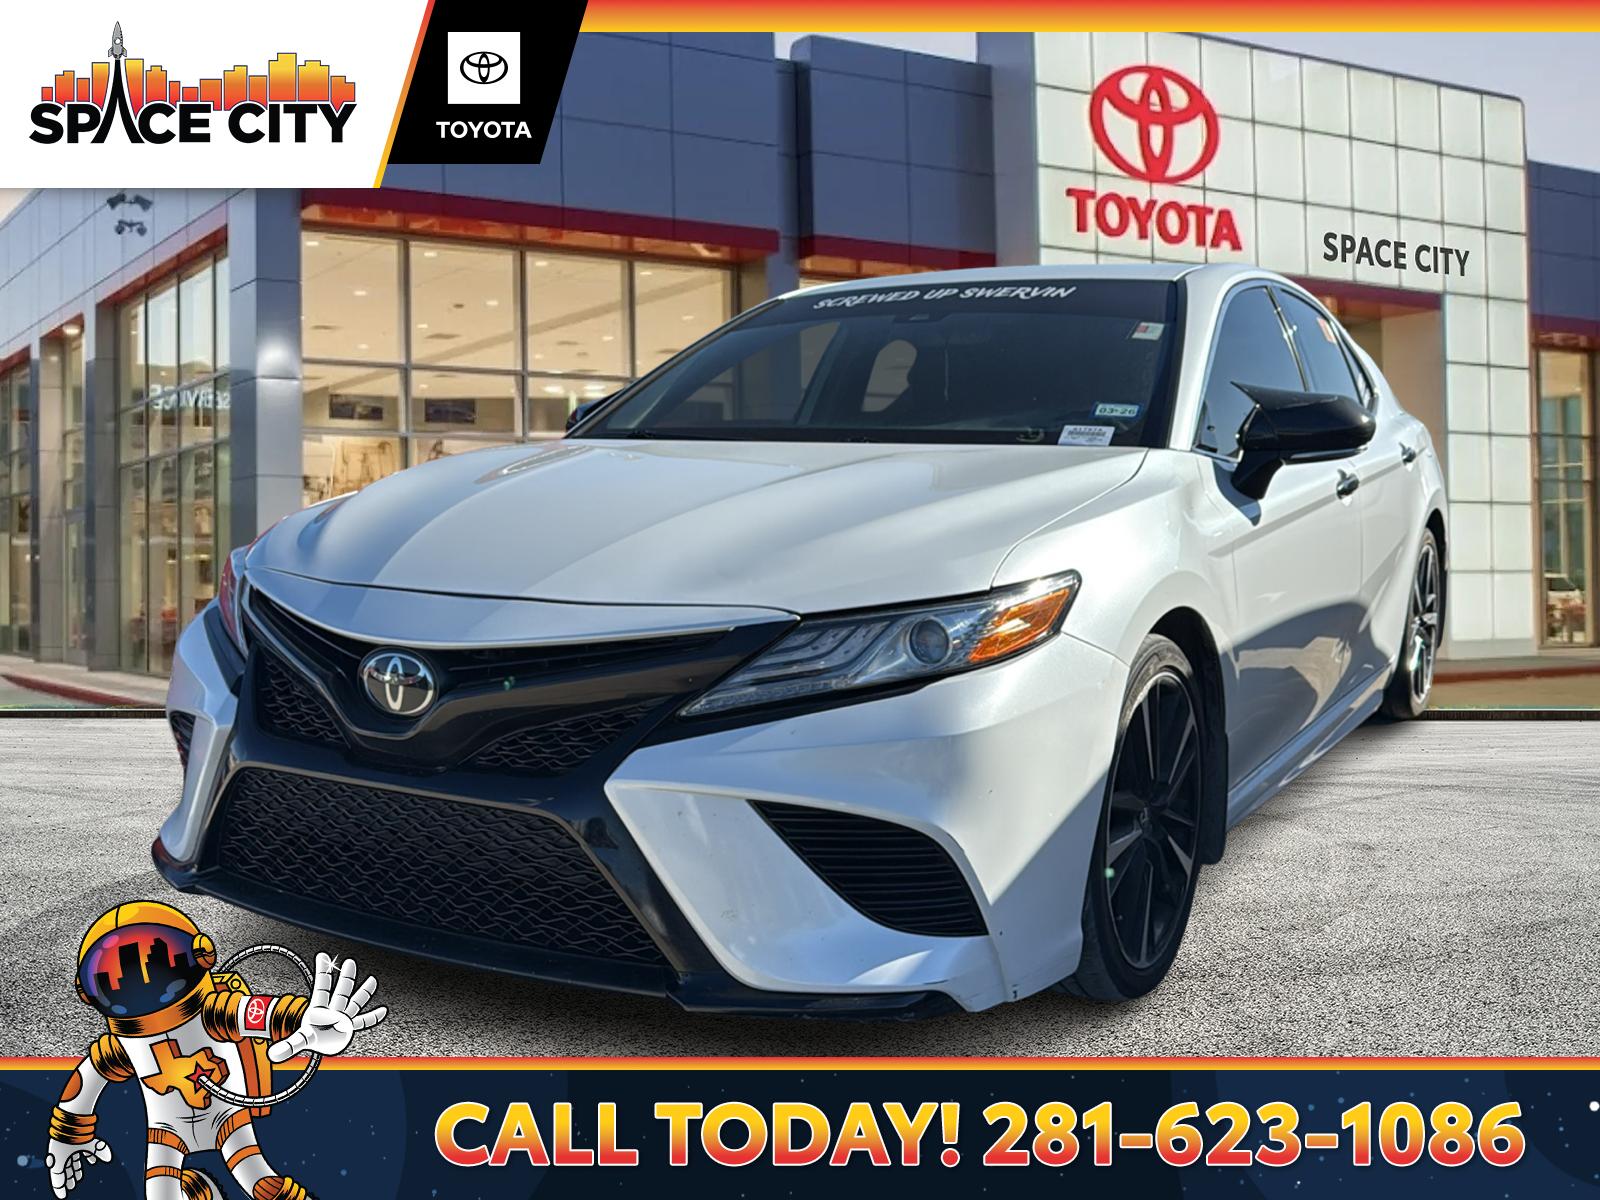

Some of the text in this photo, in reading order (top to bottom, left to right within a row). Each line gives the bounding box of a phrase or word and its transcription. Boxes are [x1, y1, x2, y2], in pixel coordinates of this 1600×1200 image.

[1065, 188, 1242, 251] TOYOTA
[1323, 232, 1470, 277] SPACE CITY
[813, 286, 1077, 309] SCREWED UP SWERVIN
